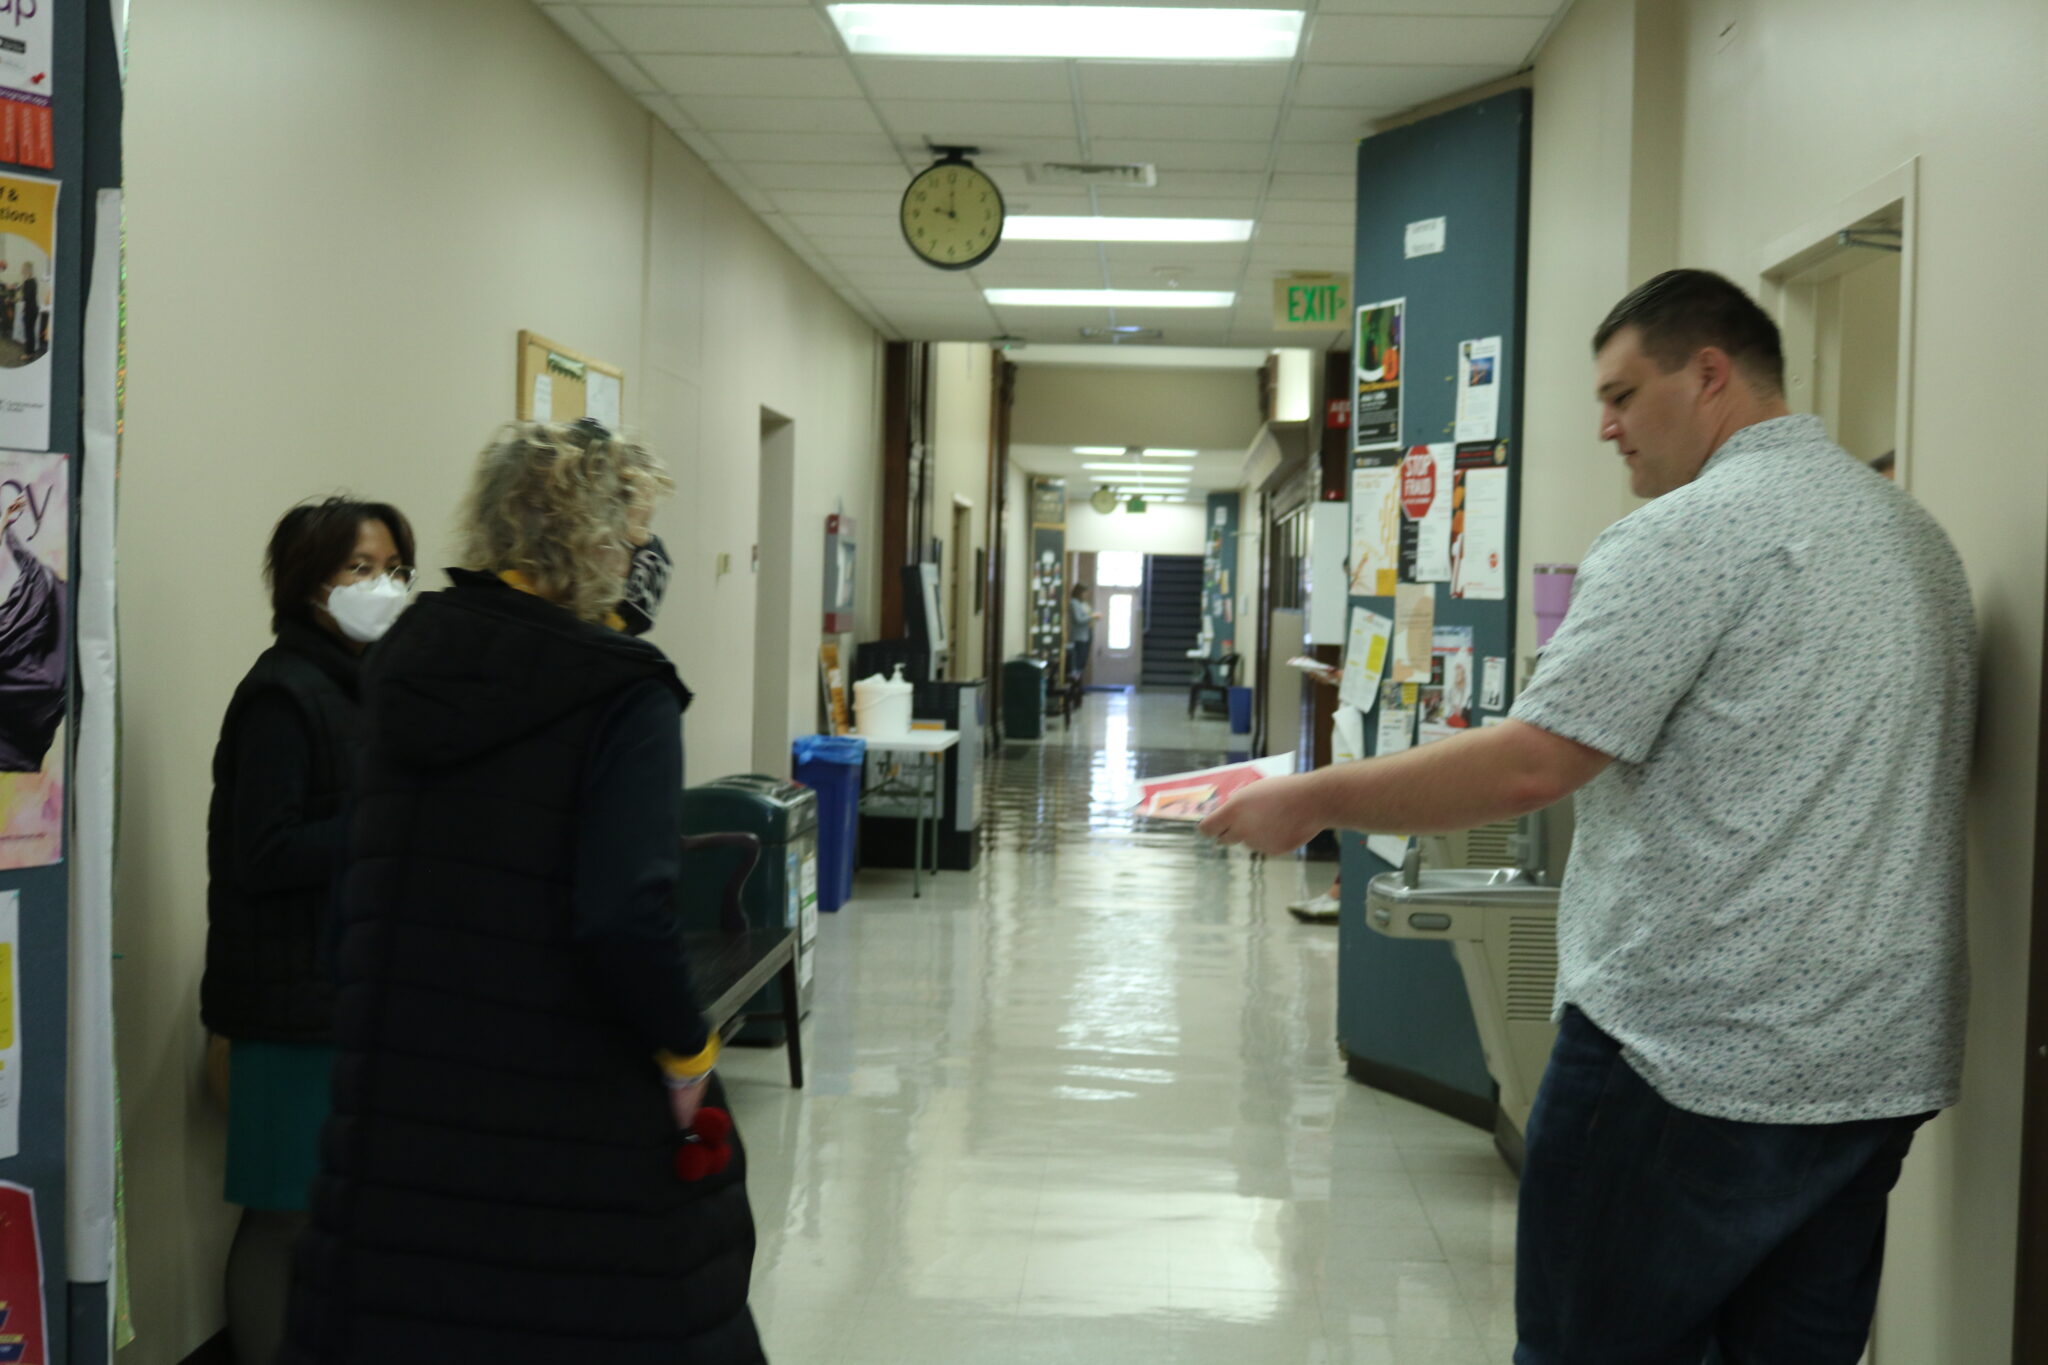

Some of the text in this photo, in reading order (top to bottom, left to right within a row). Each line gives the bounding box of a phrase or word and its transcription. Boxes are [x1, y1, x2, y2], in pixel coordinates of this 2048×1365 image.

[1288, 285, 1340, 322] EXIT
[1404, 455, 1433, 477] STOP
[1404, 478, 1432, 497] FRAUD
